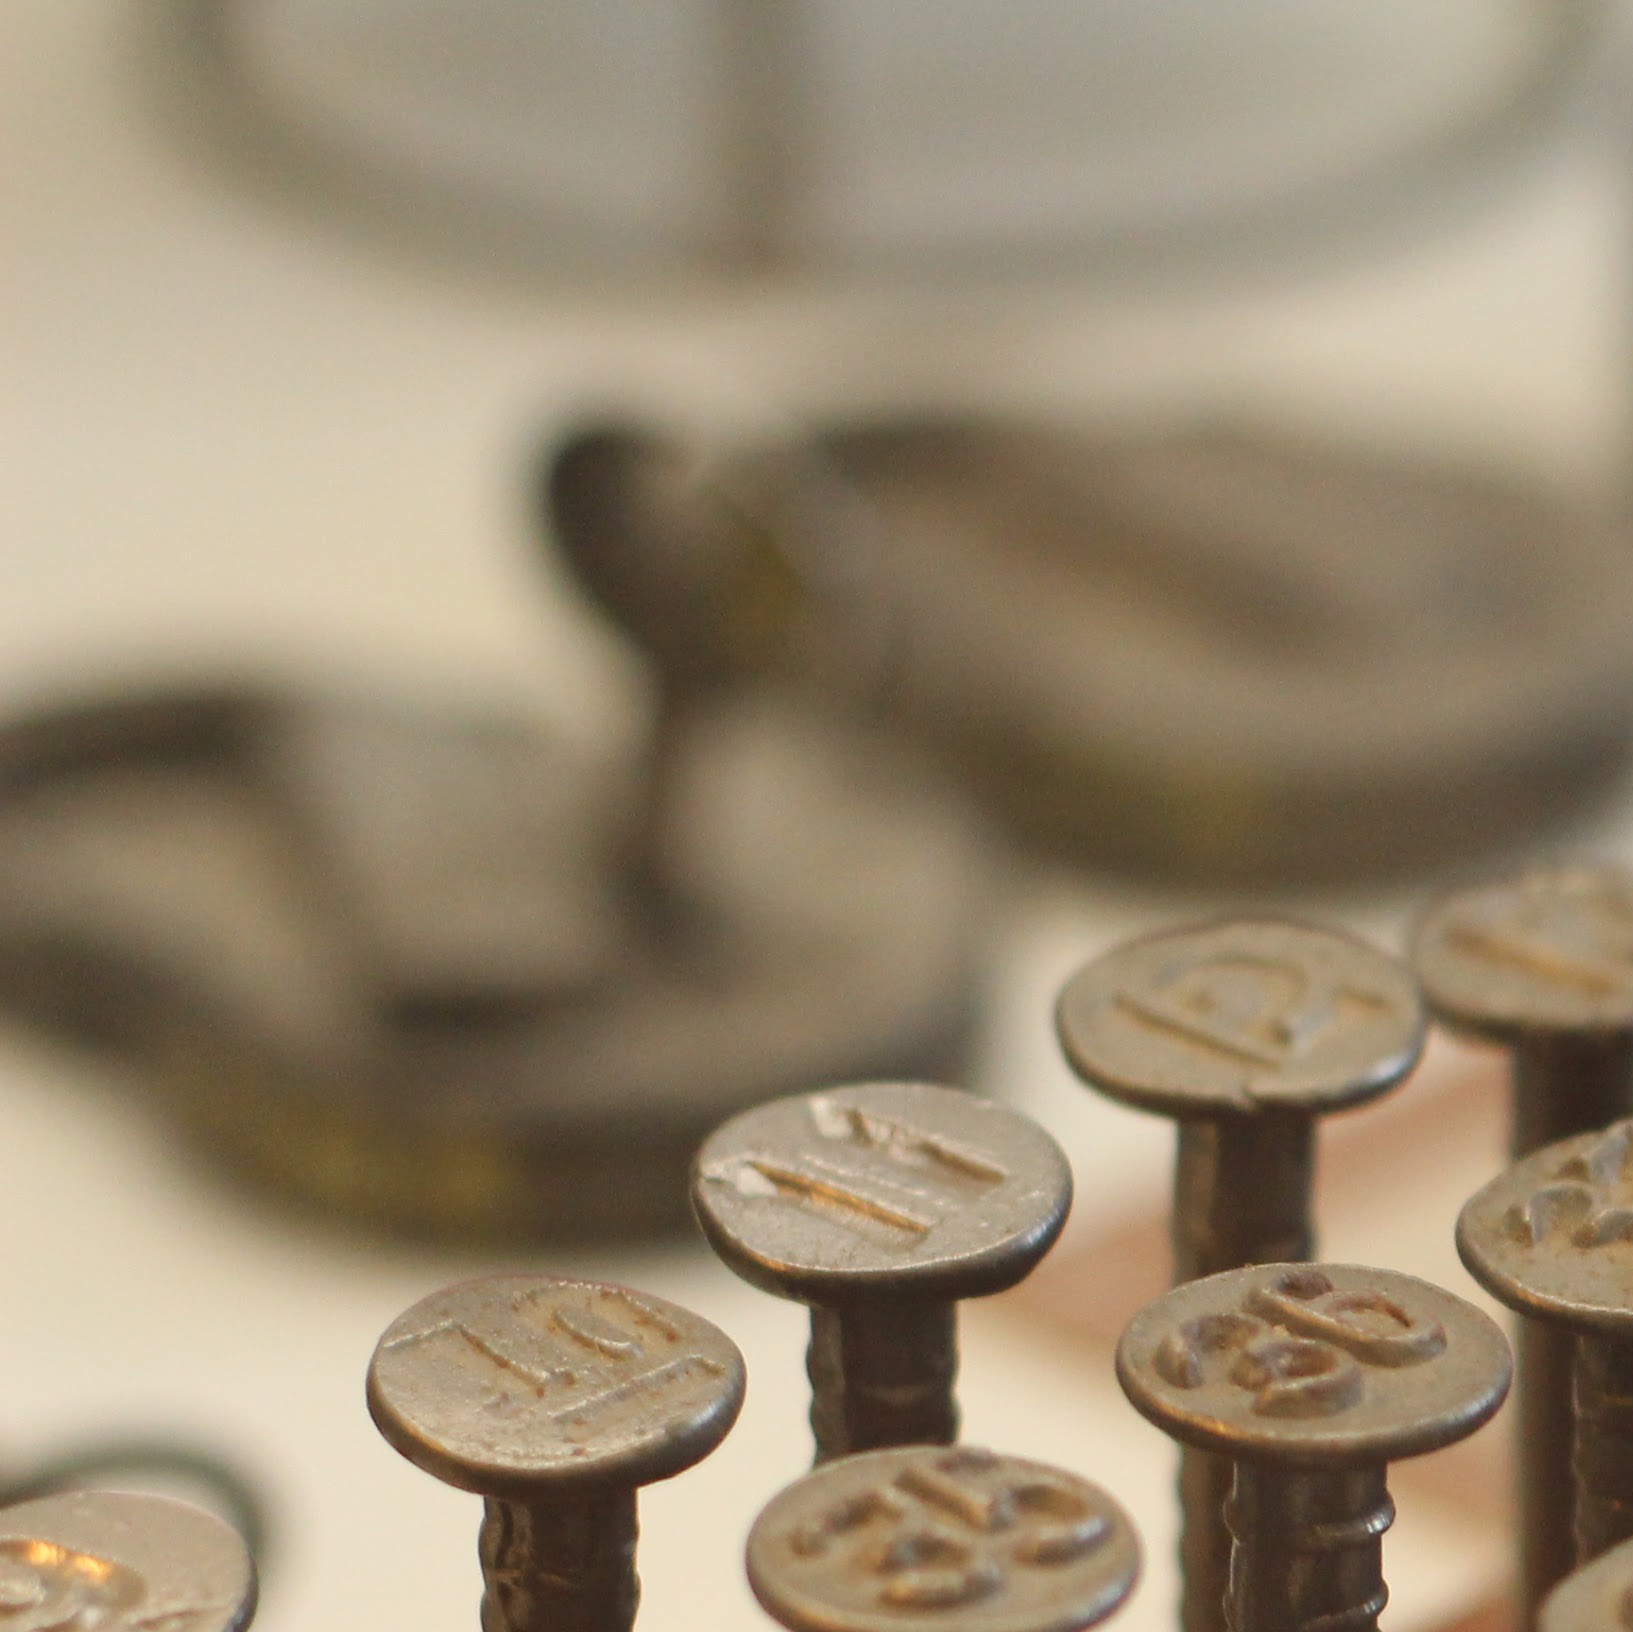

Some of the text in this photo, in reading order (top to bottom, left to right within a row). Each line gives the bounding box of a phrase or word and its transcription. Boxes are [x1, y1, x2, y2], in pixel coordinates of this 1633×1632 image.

[698, 1095, 1008, 1242] 11
[1153, 1268, 1442, 1415] 36
[785, 1455, 1112, 1608] 35
